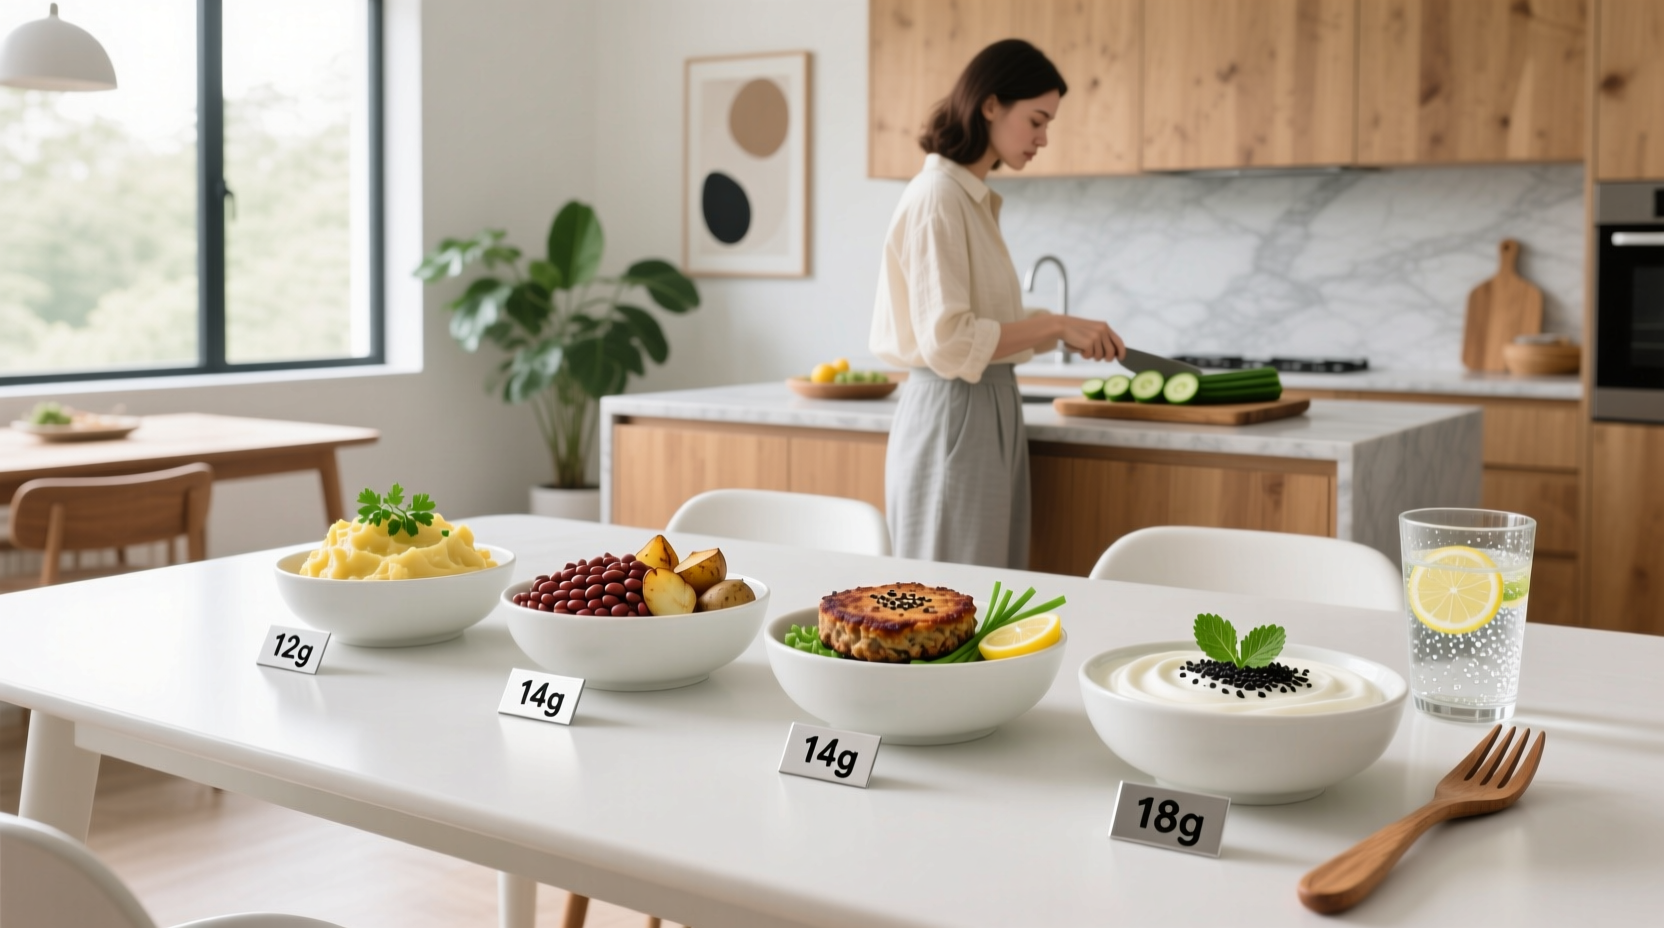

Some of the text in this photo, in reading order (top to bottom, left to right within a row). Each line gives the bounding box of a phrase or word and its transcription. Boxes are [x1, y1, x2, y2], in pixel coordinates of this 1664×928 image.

[273, 633, 314, 668] 12g
[520, 679, 565, 718] 14g
[805, 735, 859, 779] 14g
[1137, 796, 1205, 848] 18g
